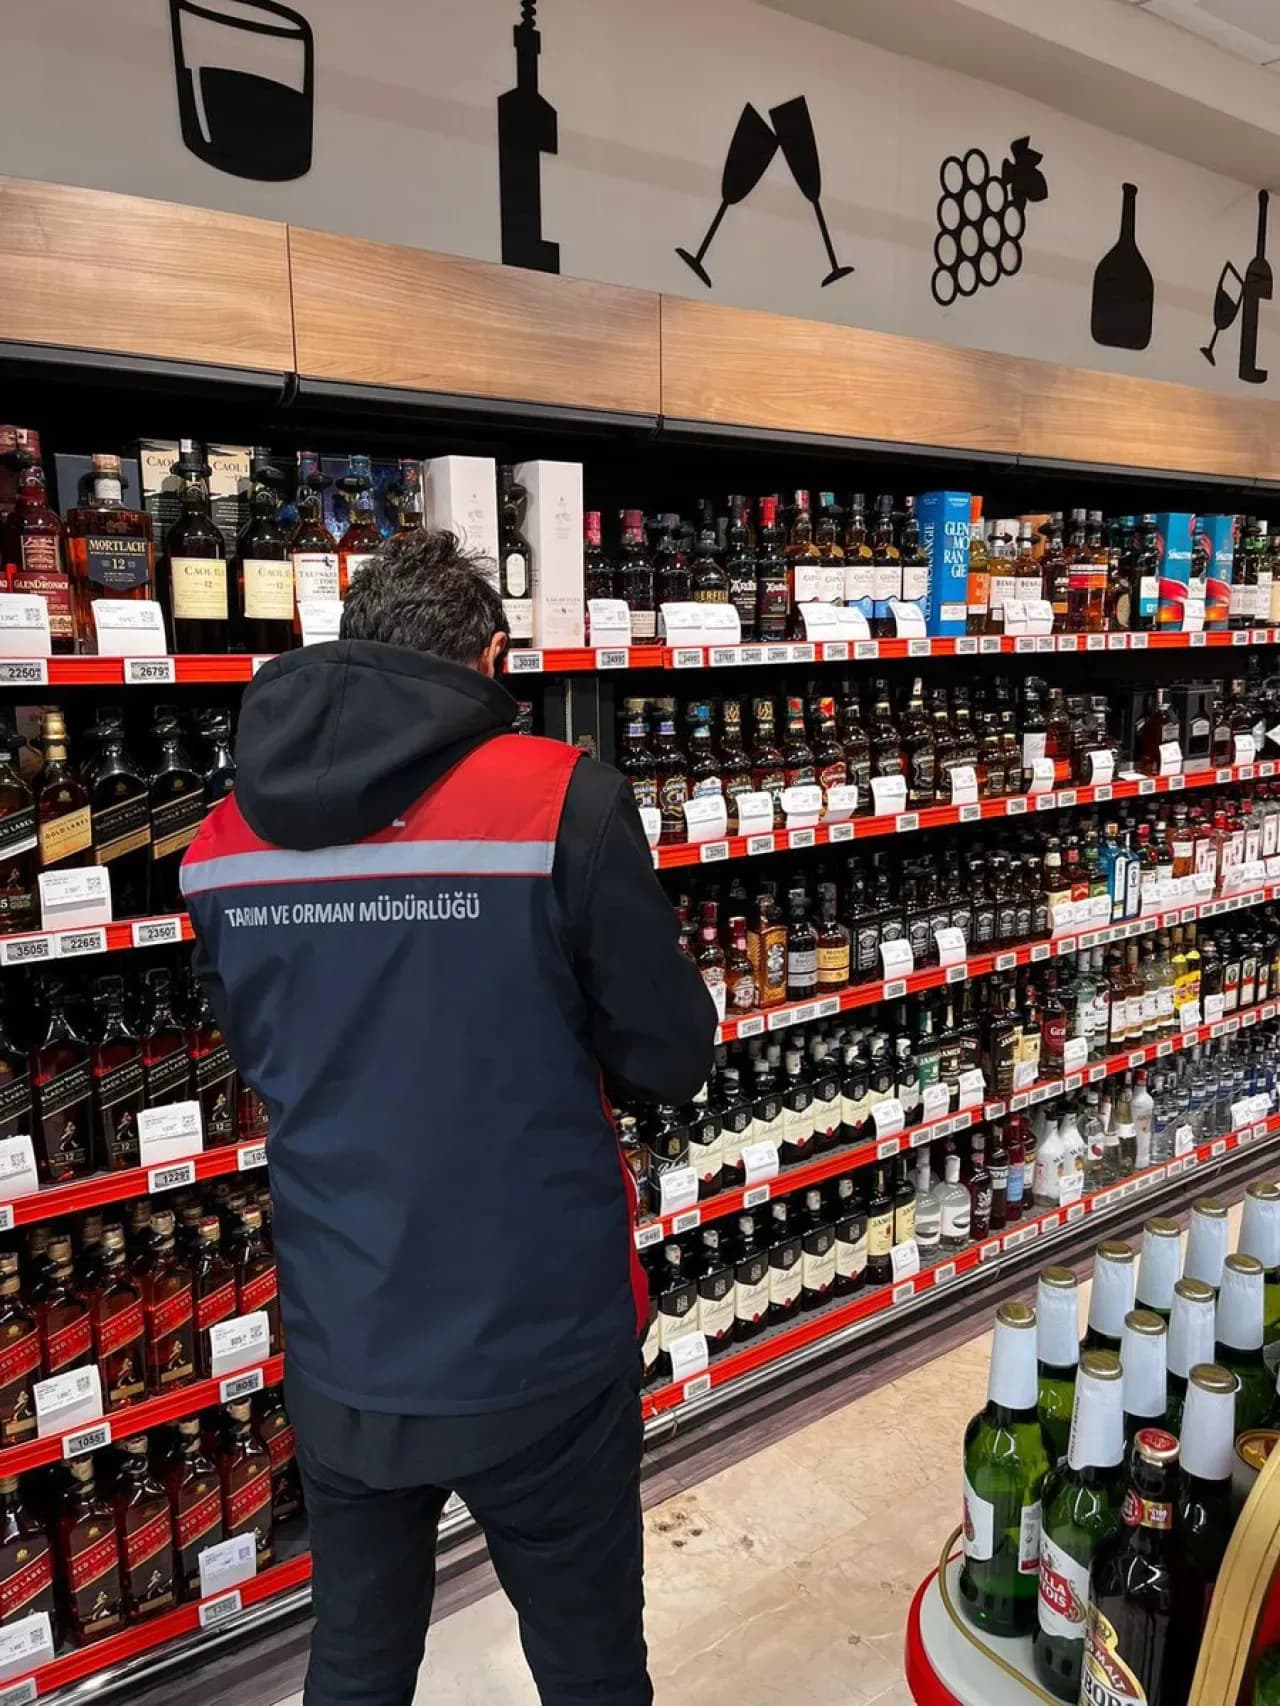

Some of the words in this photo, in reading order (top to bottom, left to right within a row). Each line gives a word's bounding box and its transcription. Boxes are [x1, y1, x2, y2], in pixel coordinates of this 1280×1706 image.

[945, 521, 970, 536] GLEN
[89, 539, 146, 553] MORTLACH
[953, 536, 970, 550] MO
[112, 558, 126, 569] 12
[944, 550, 965, 564] RAN
[184, 565, 212, 577] CAOL
[951, 564, 968, 578] GIE
[224, 906, 268, 927] TARIM
[270, 905, 290, 925] VE
[292, 903, 355, 924] ORMAN
[359, 891, 480, 922] MÜDÜRLÜĞÜ
[77, 1435, 101, 1448] 1055
[1, 1585, 19, 1600] RED
[20, 1565, 47, 1587] LABEL
[1095, 1649, 1127, 1690] MALT
